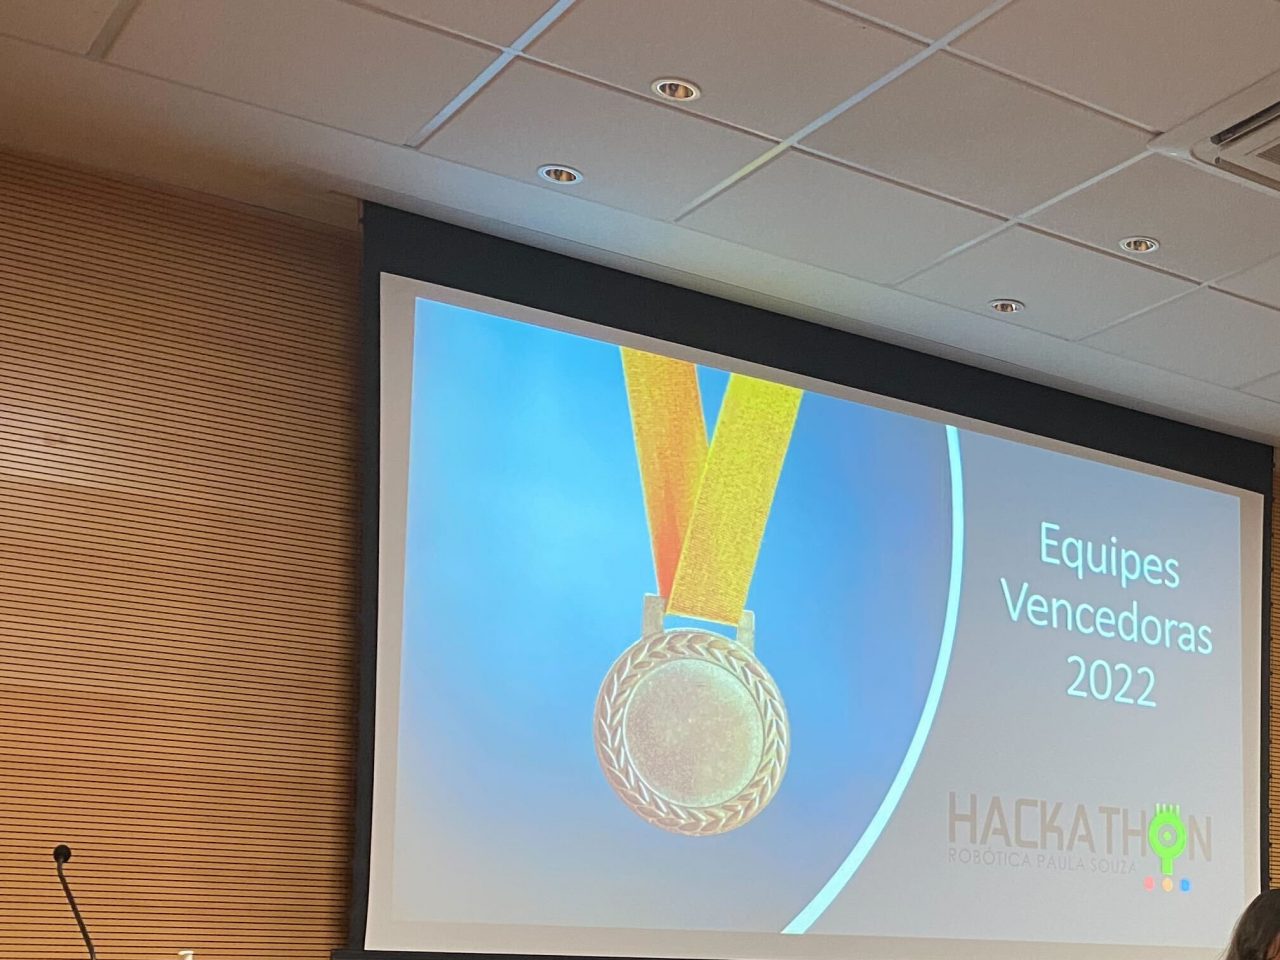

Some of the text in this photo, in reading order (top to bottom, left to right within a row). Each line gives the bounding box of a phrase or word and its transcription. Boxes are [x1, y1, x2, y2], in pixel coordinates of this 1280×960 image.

[1040, 521, 1180, 589] Equipes
[1000, 577, 1213, 655] Vencedoras
[1066, 655, 1157, 707] 2022
[948, 791, 1213, 876] HACKATHON
[948, 844, 1138, 875] ROBÓTICA PAULA SOUZA
